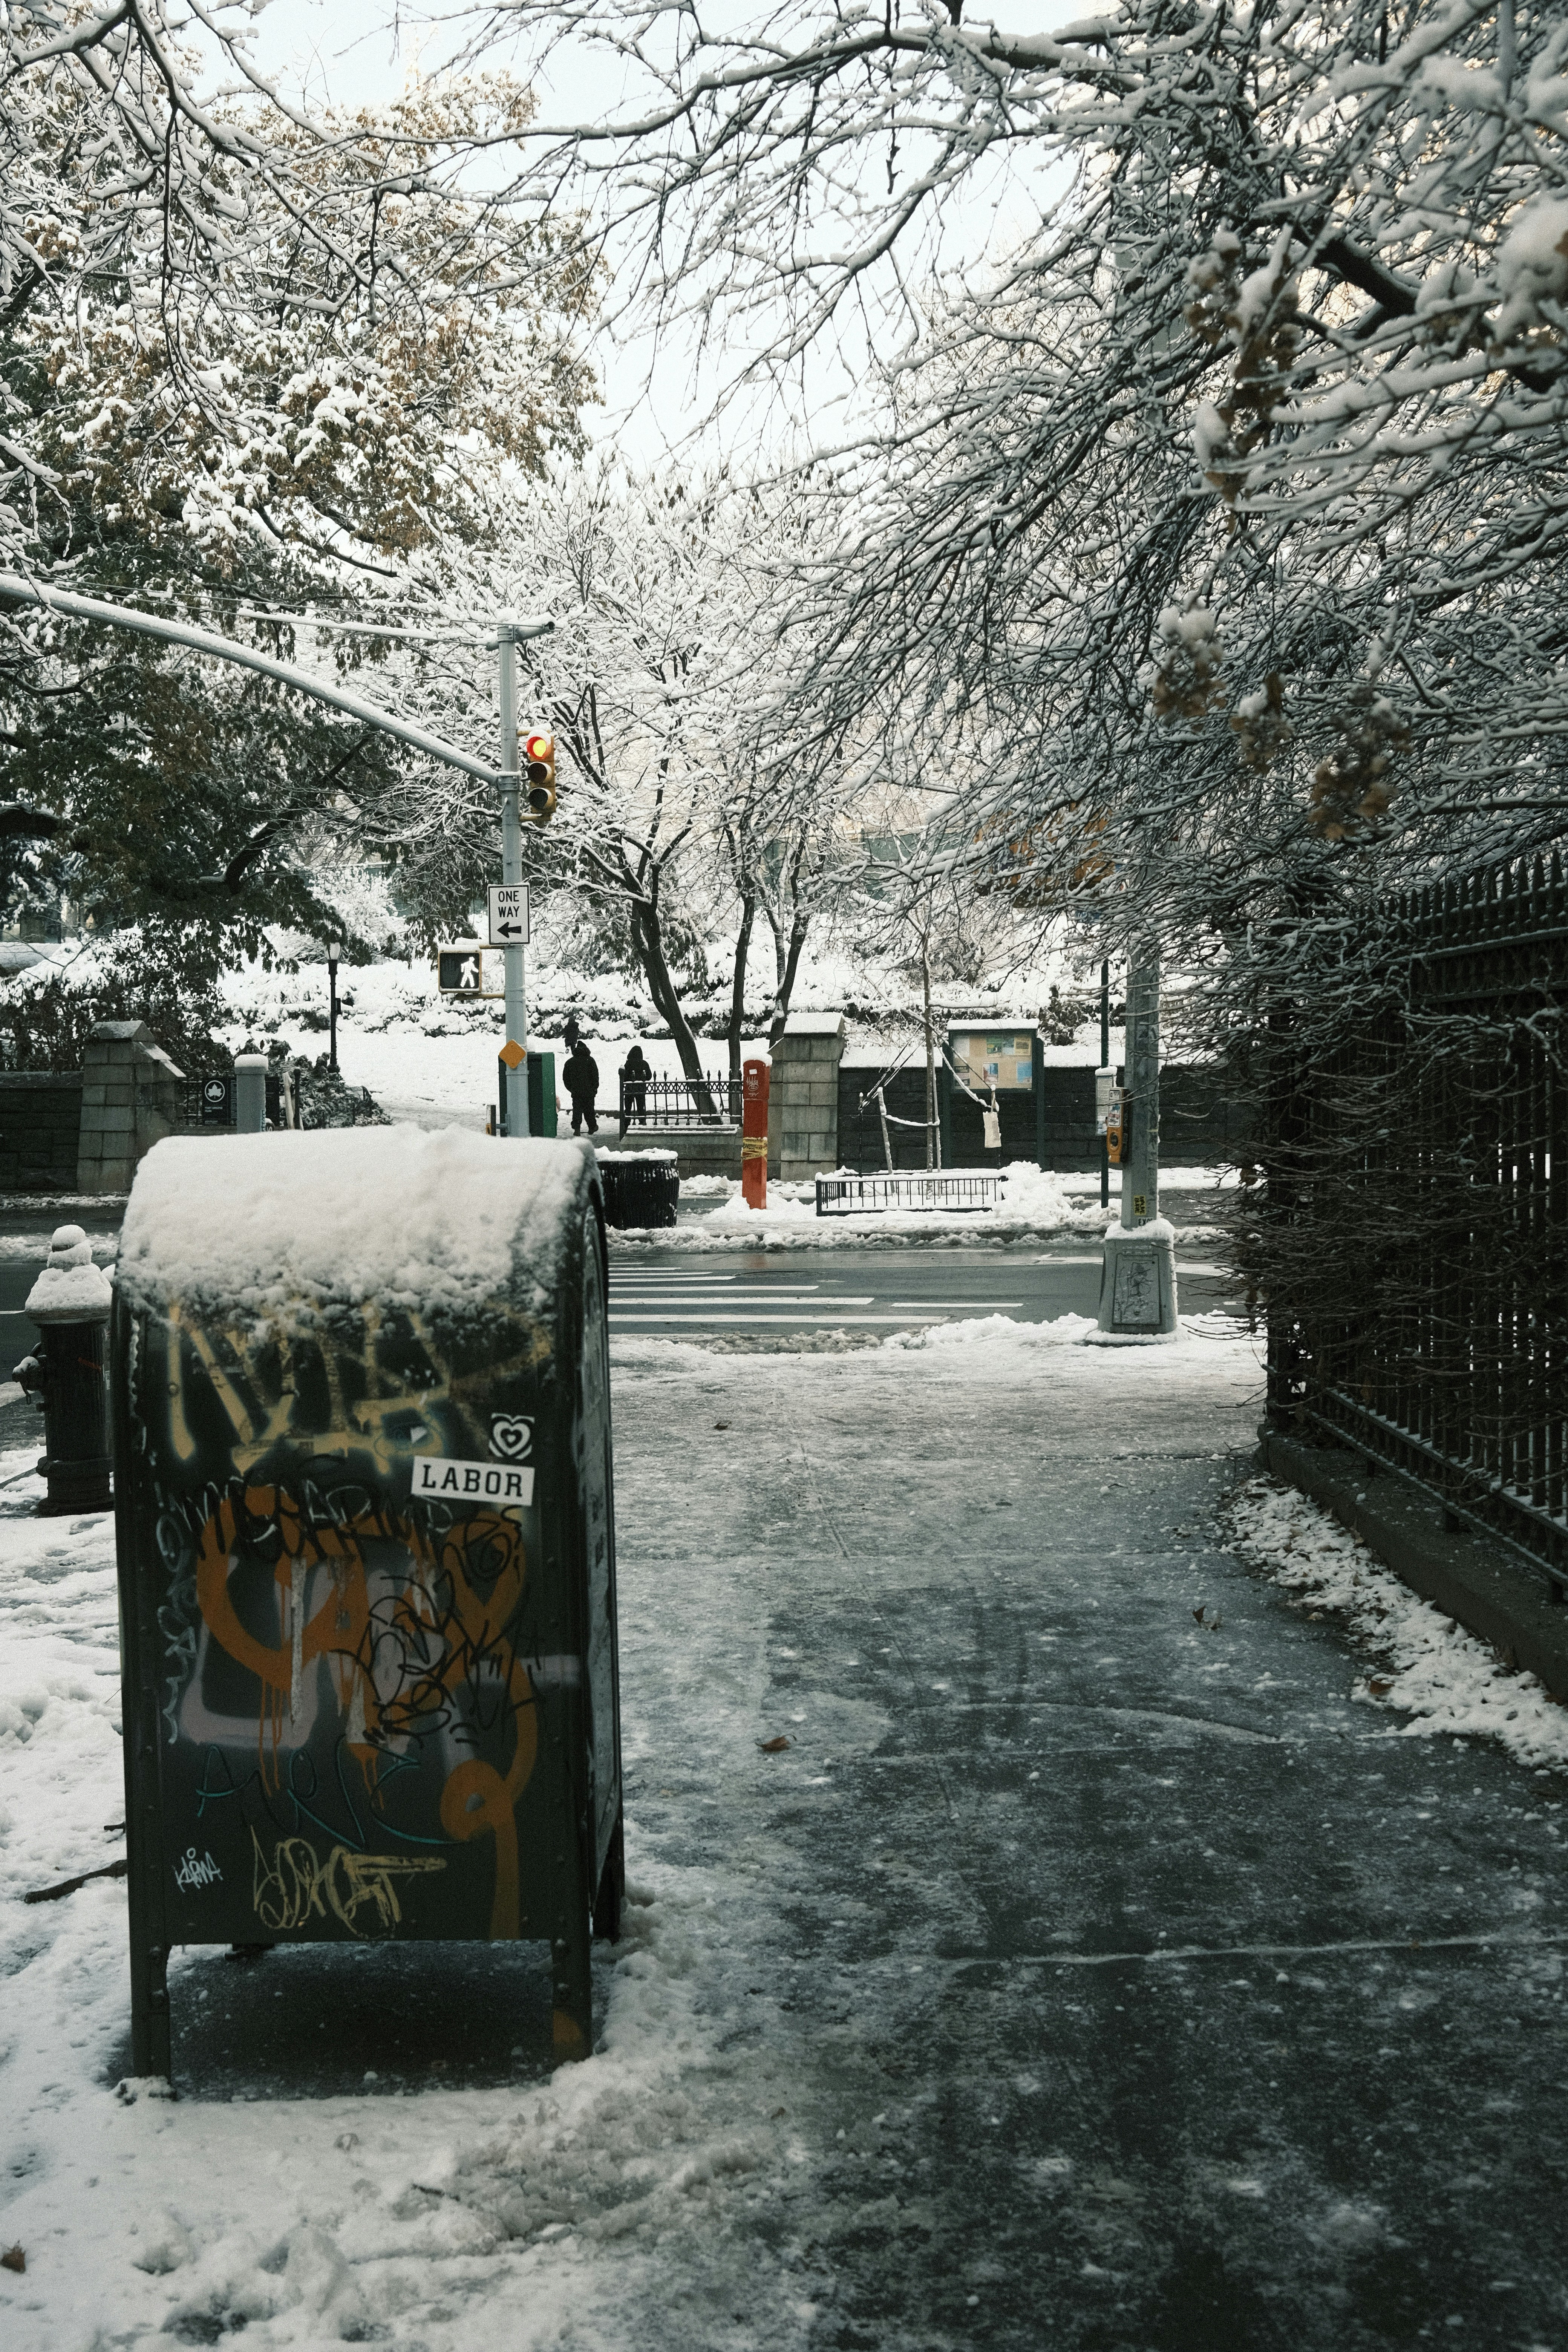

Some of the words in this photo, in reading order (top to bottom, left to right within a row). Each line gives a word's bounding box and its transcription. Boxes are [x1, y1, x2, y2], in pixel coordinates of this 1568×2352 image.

[498, 890, 519, 902] ONE
[498, 906, 519, 918] WAY
[421, 1464, 523, 1498] LABOR
